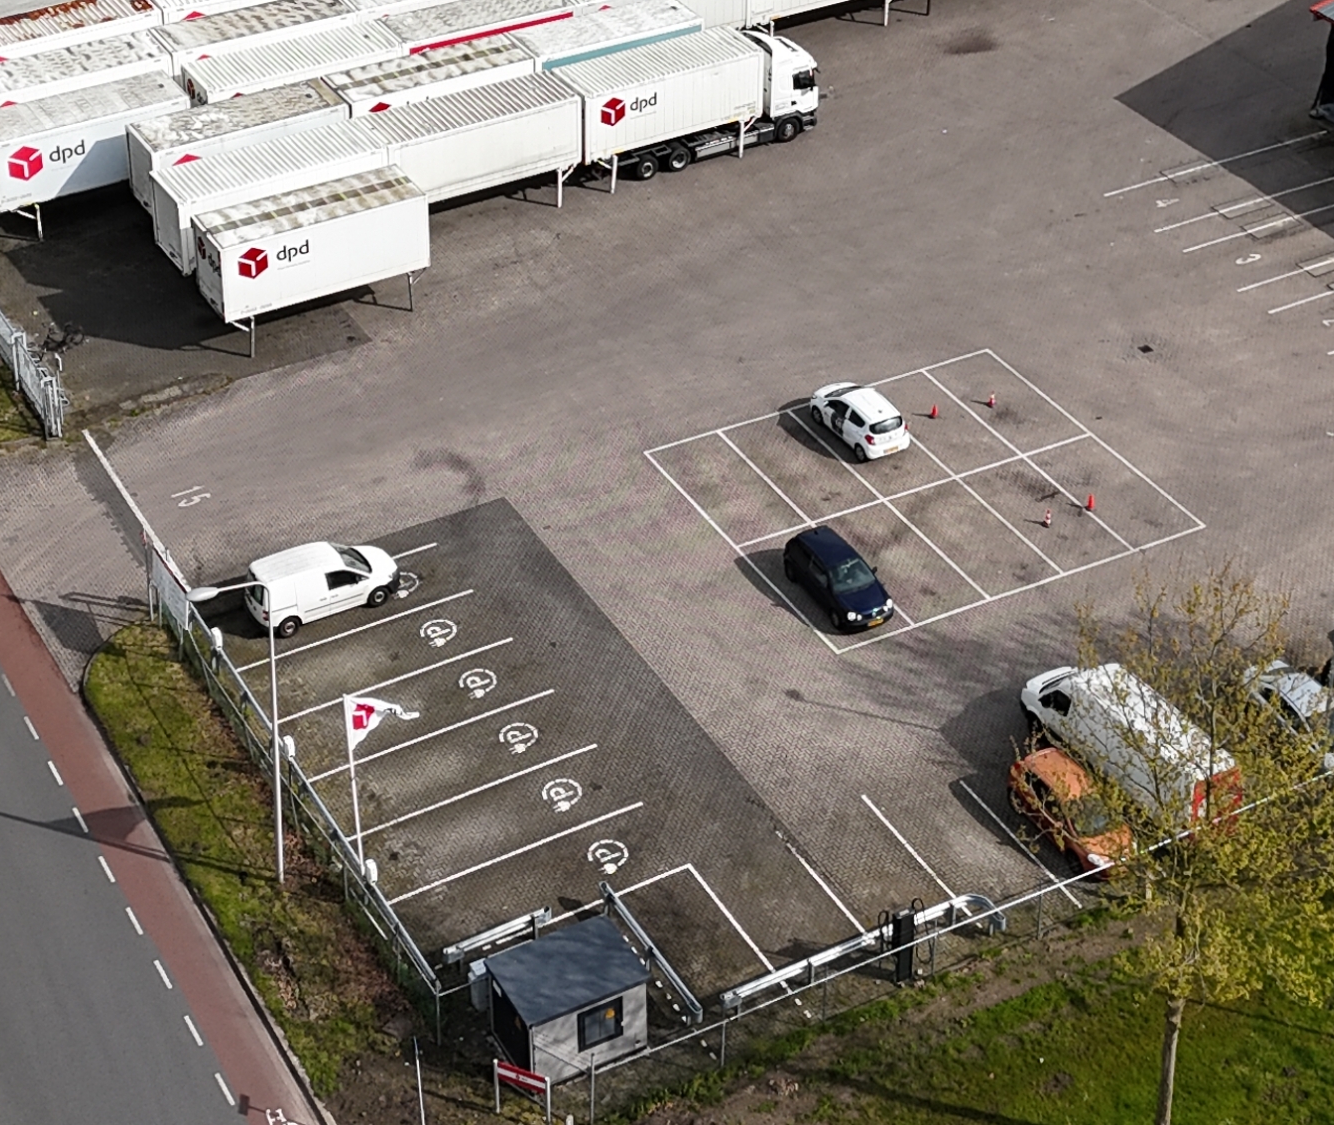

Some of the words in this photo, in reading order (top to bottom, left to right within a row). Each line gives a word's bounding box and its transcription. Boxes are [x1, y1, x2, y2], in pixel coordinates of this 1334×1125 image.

[629, 91, 658, 113] dpd
[48, 138, 86, 164] dpd
[275, 238, 310, 263] dpd
[1235, 253, 1262, 265] 3
